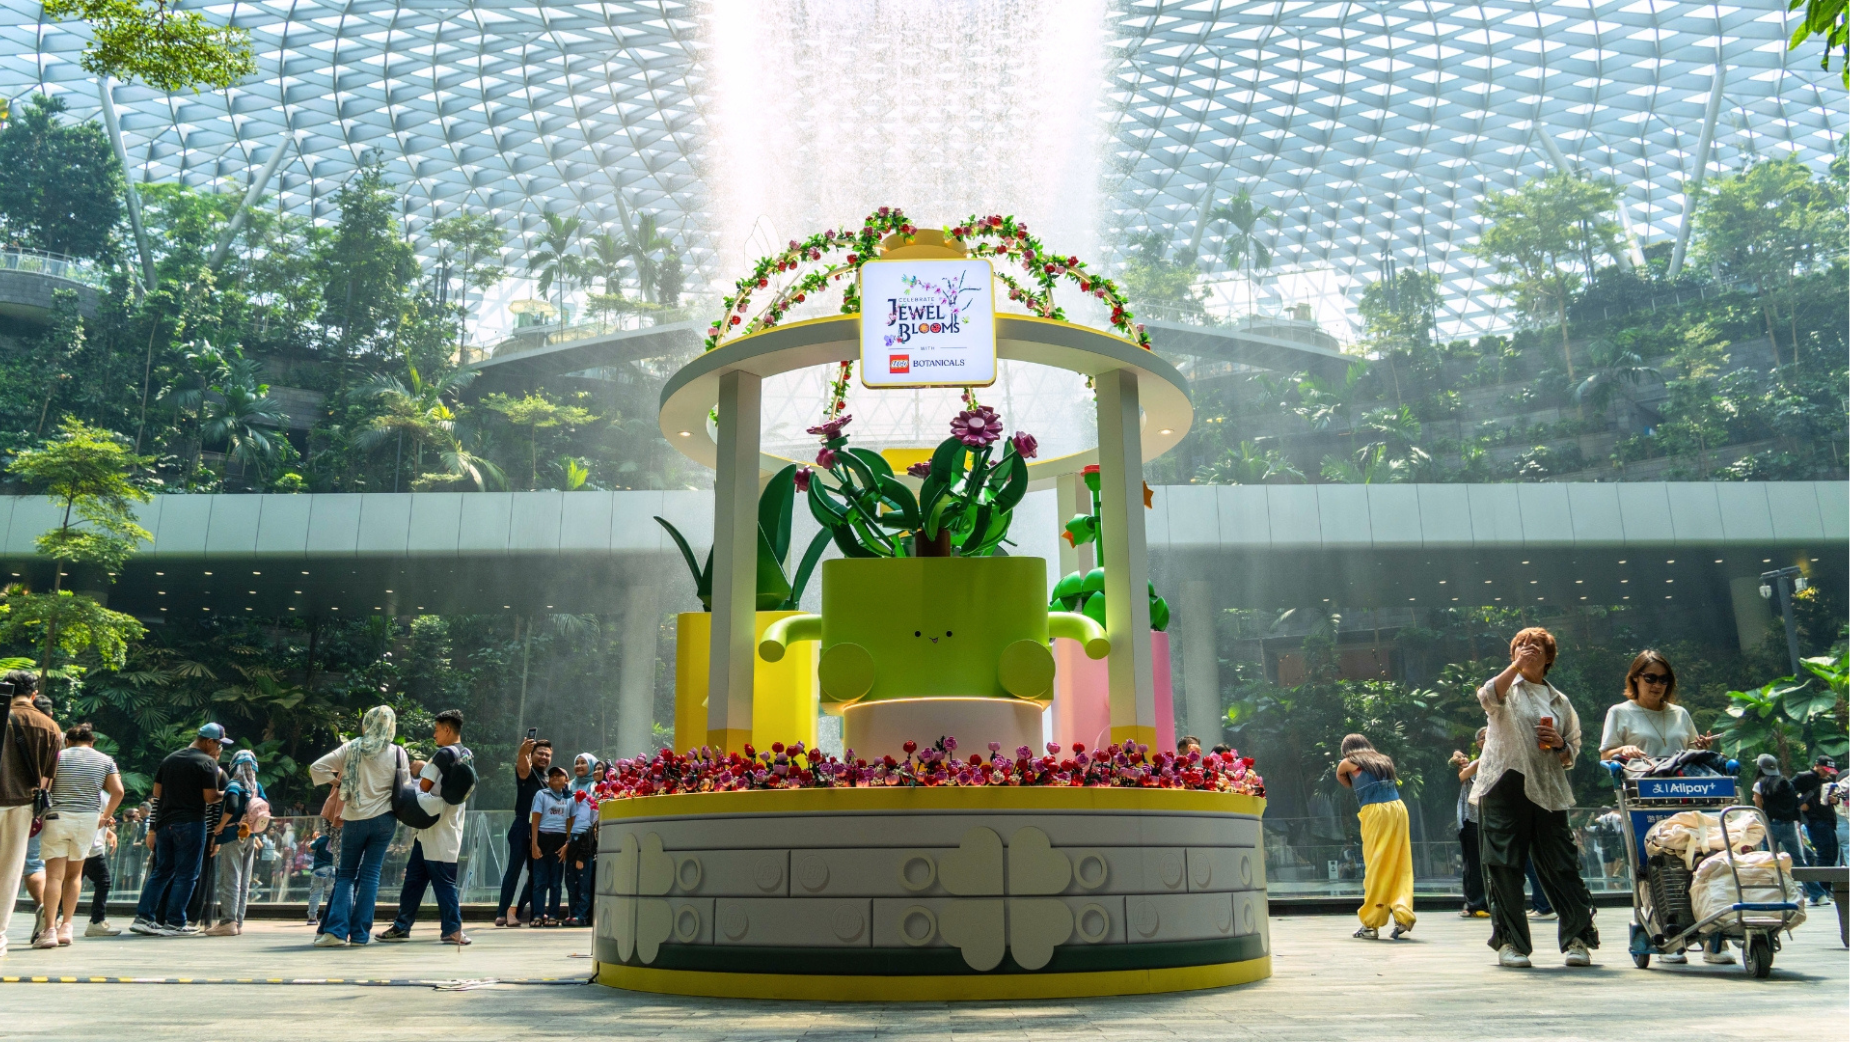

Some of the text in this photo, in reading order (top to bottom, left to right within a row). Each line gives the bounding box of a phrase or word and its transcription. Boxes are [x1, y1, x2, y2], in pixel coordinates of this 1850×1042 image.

[887, 298, 946, 326] JEWEL
[898, 322, 960, 343] BLOOMS
[913, 359, 965, 368] BOTANICALS
[1670, 782, 1716, 795] Alipay+
